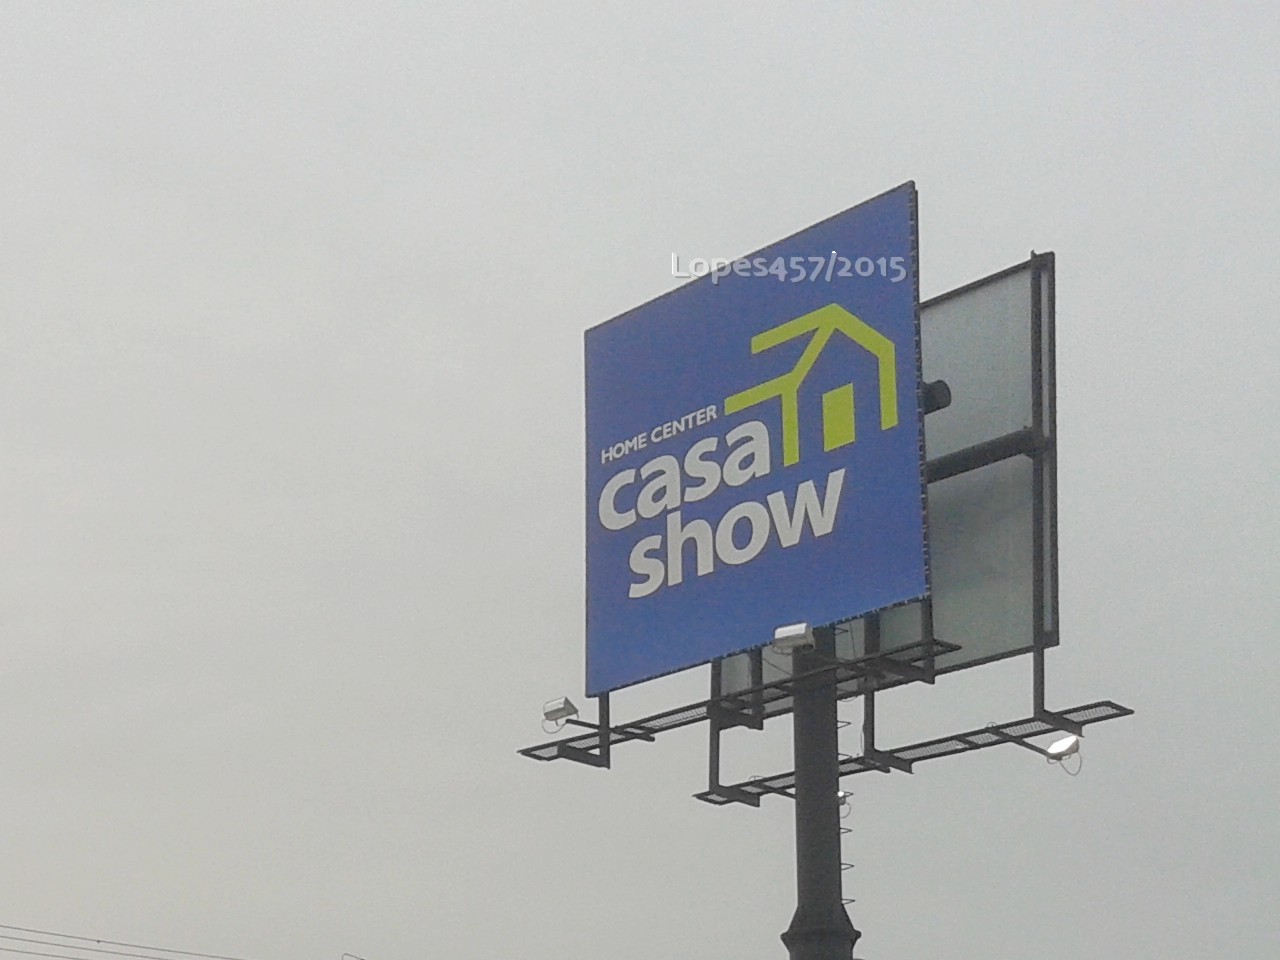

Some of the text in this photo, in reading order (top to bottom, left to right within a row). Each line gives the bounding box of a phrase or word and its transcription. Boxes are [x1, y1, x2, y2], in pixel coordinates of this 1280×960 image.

[598, 420, 771, 531] casa
[601, 404, 718, 464] HOME CENTER
[628, 468, 847, 599] show
